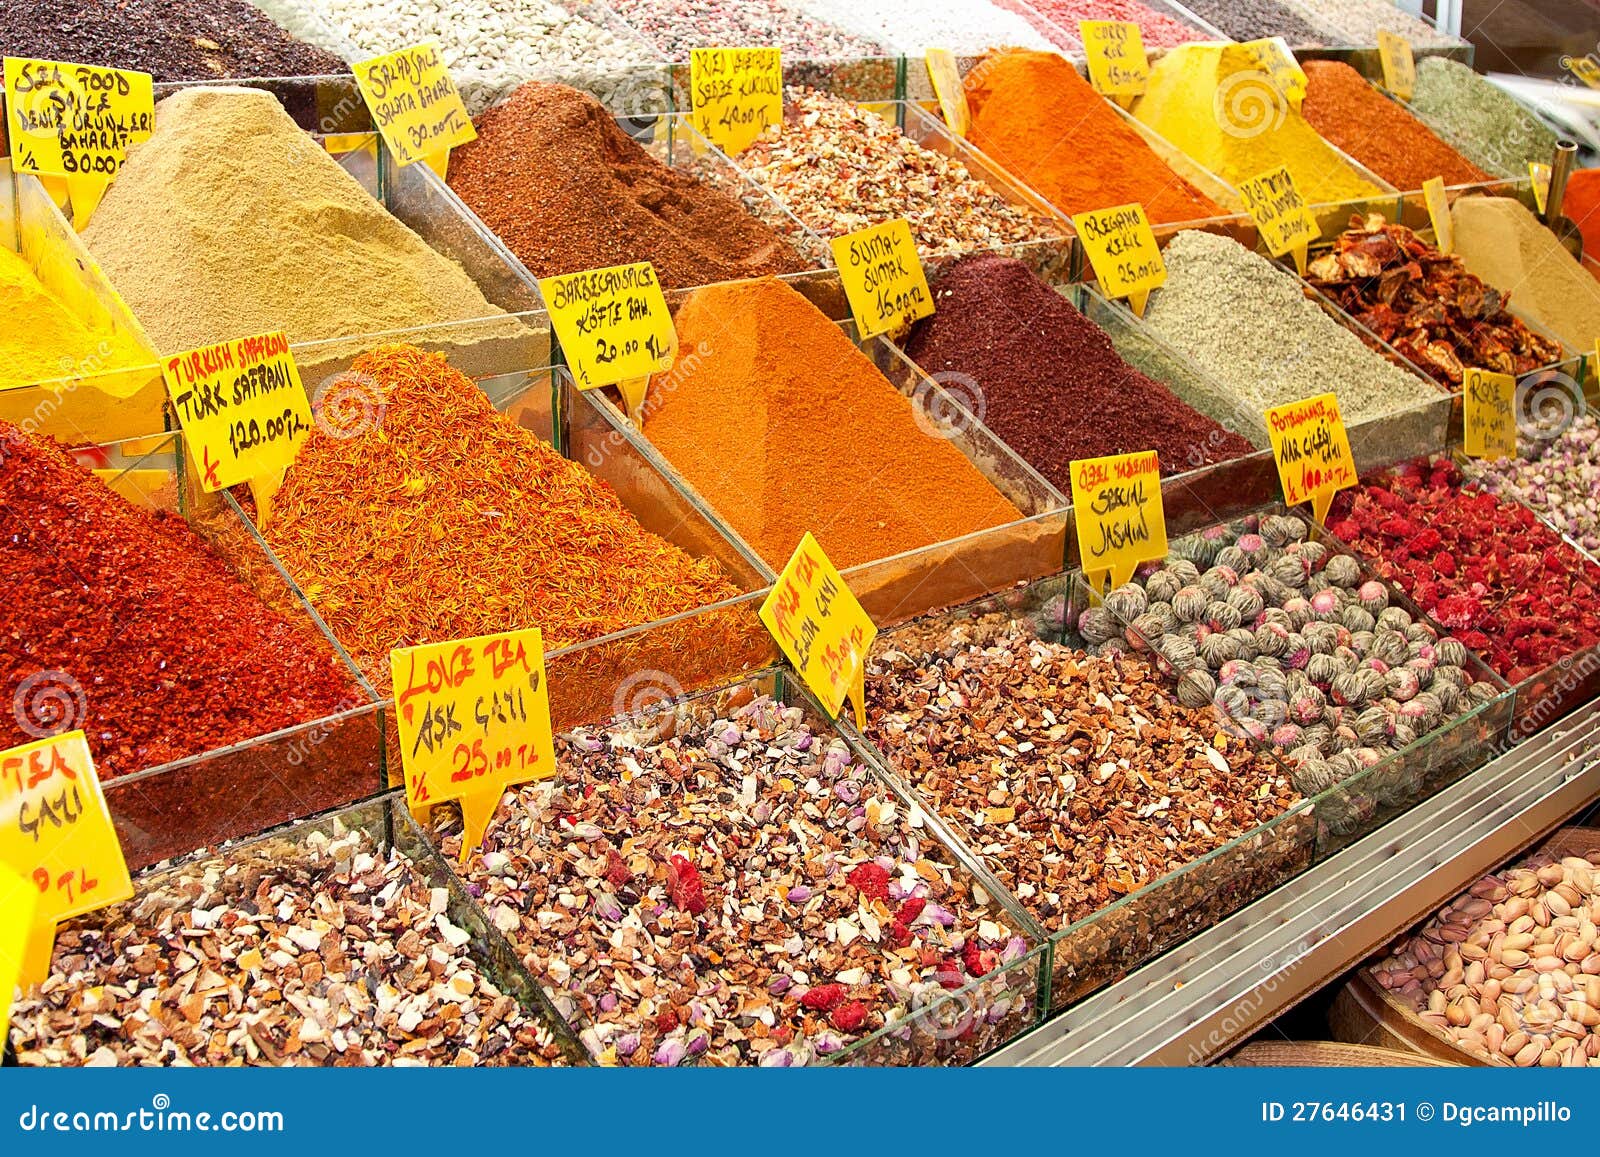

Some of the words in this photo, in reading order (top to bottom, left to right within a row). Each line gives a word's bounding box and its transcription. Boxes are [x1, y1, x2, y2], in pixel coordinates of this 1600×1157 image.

[15, 63, 65, 92] SEA
[76, 67, 130, 96] FOOD
[50, 91, 111, 115] SPICE
[1084, 209, 1140, 241] OREGANO
[850, 230, 901, 266] SUMAC
[864, 255, 908, 293] SUMAK
[168, 343, 234, 386] TURKISH
[596, 338, 638, 364] 20.00
[233, 360, 292, 406] SAFRANI
[1469, 372, 1500, 405] ROSE
[1281, 435, 1301, 467] NAR
[1091, 480, 1148, 515] SPECIAL
[1091, 506, 1149, 557] JASMIN
[796, 551, 820, 587] TEA
[399, 650, 475, 706] LOVE
[484, 639, 530, 679] TEA
[2, 746, 77, 793] TEA
[518, 744, 538, 769] TL
[57, 869, 97, 904] TL
